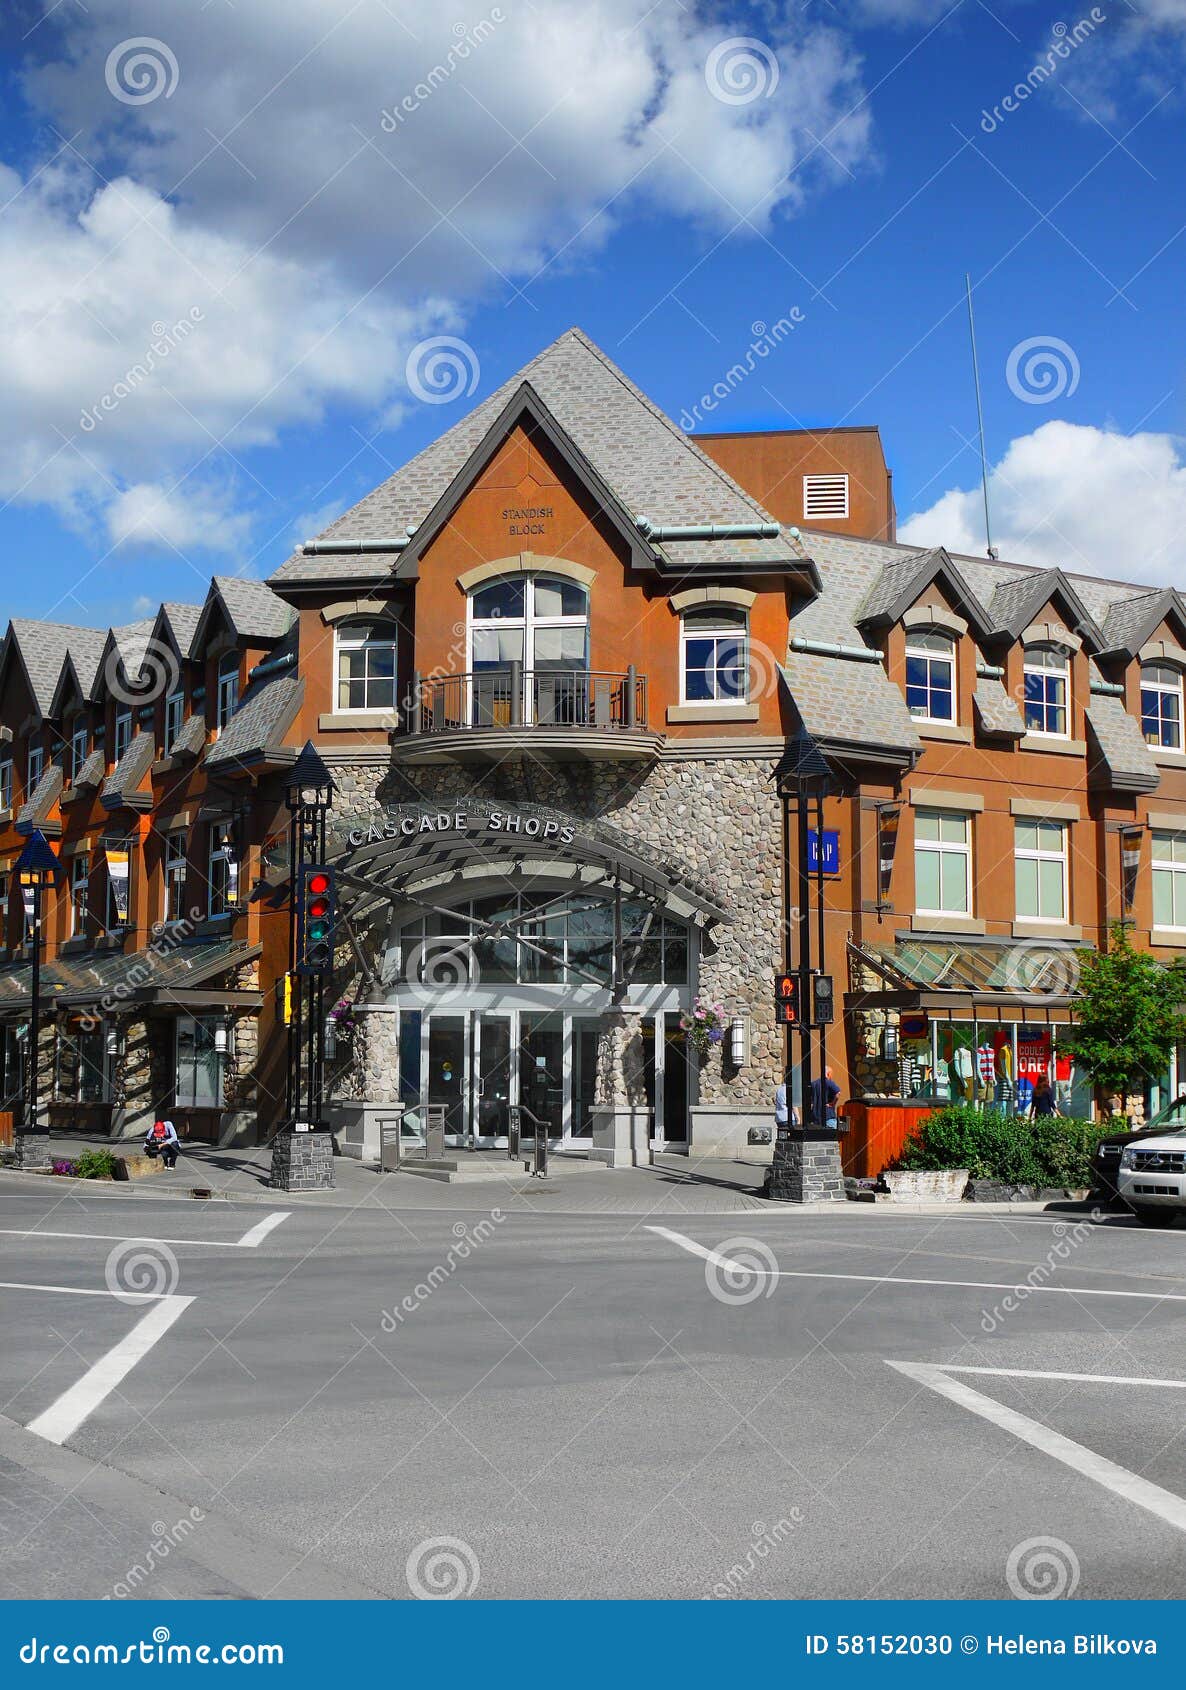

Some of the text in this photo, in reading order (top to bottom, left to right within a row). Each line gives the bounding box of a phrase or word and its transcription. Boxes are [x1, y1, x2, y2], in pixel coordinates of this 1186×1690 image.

[502, 508, 553, 519] STANDISH
[509, 525, 545, 535] BLOCK
[349, 812, 576, 846] CASCADE SHOPS
[1017, 1057, 1045, 1073] ORE
